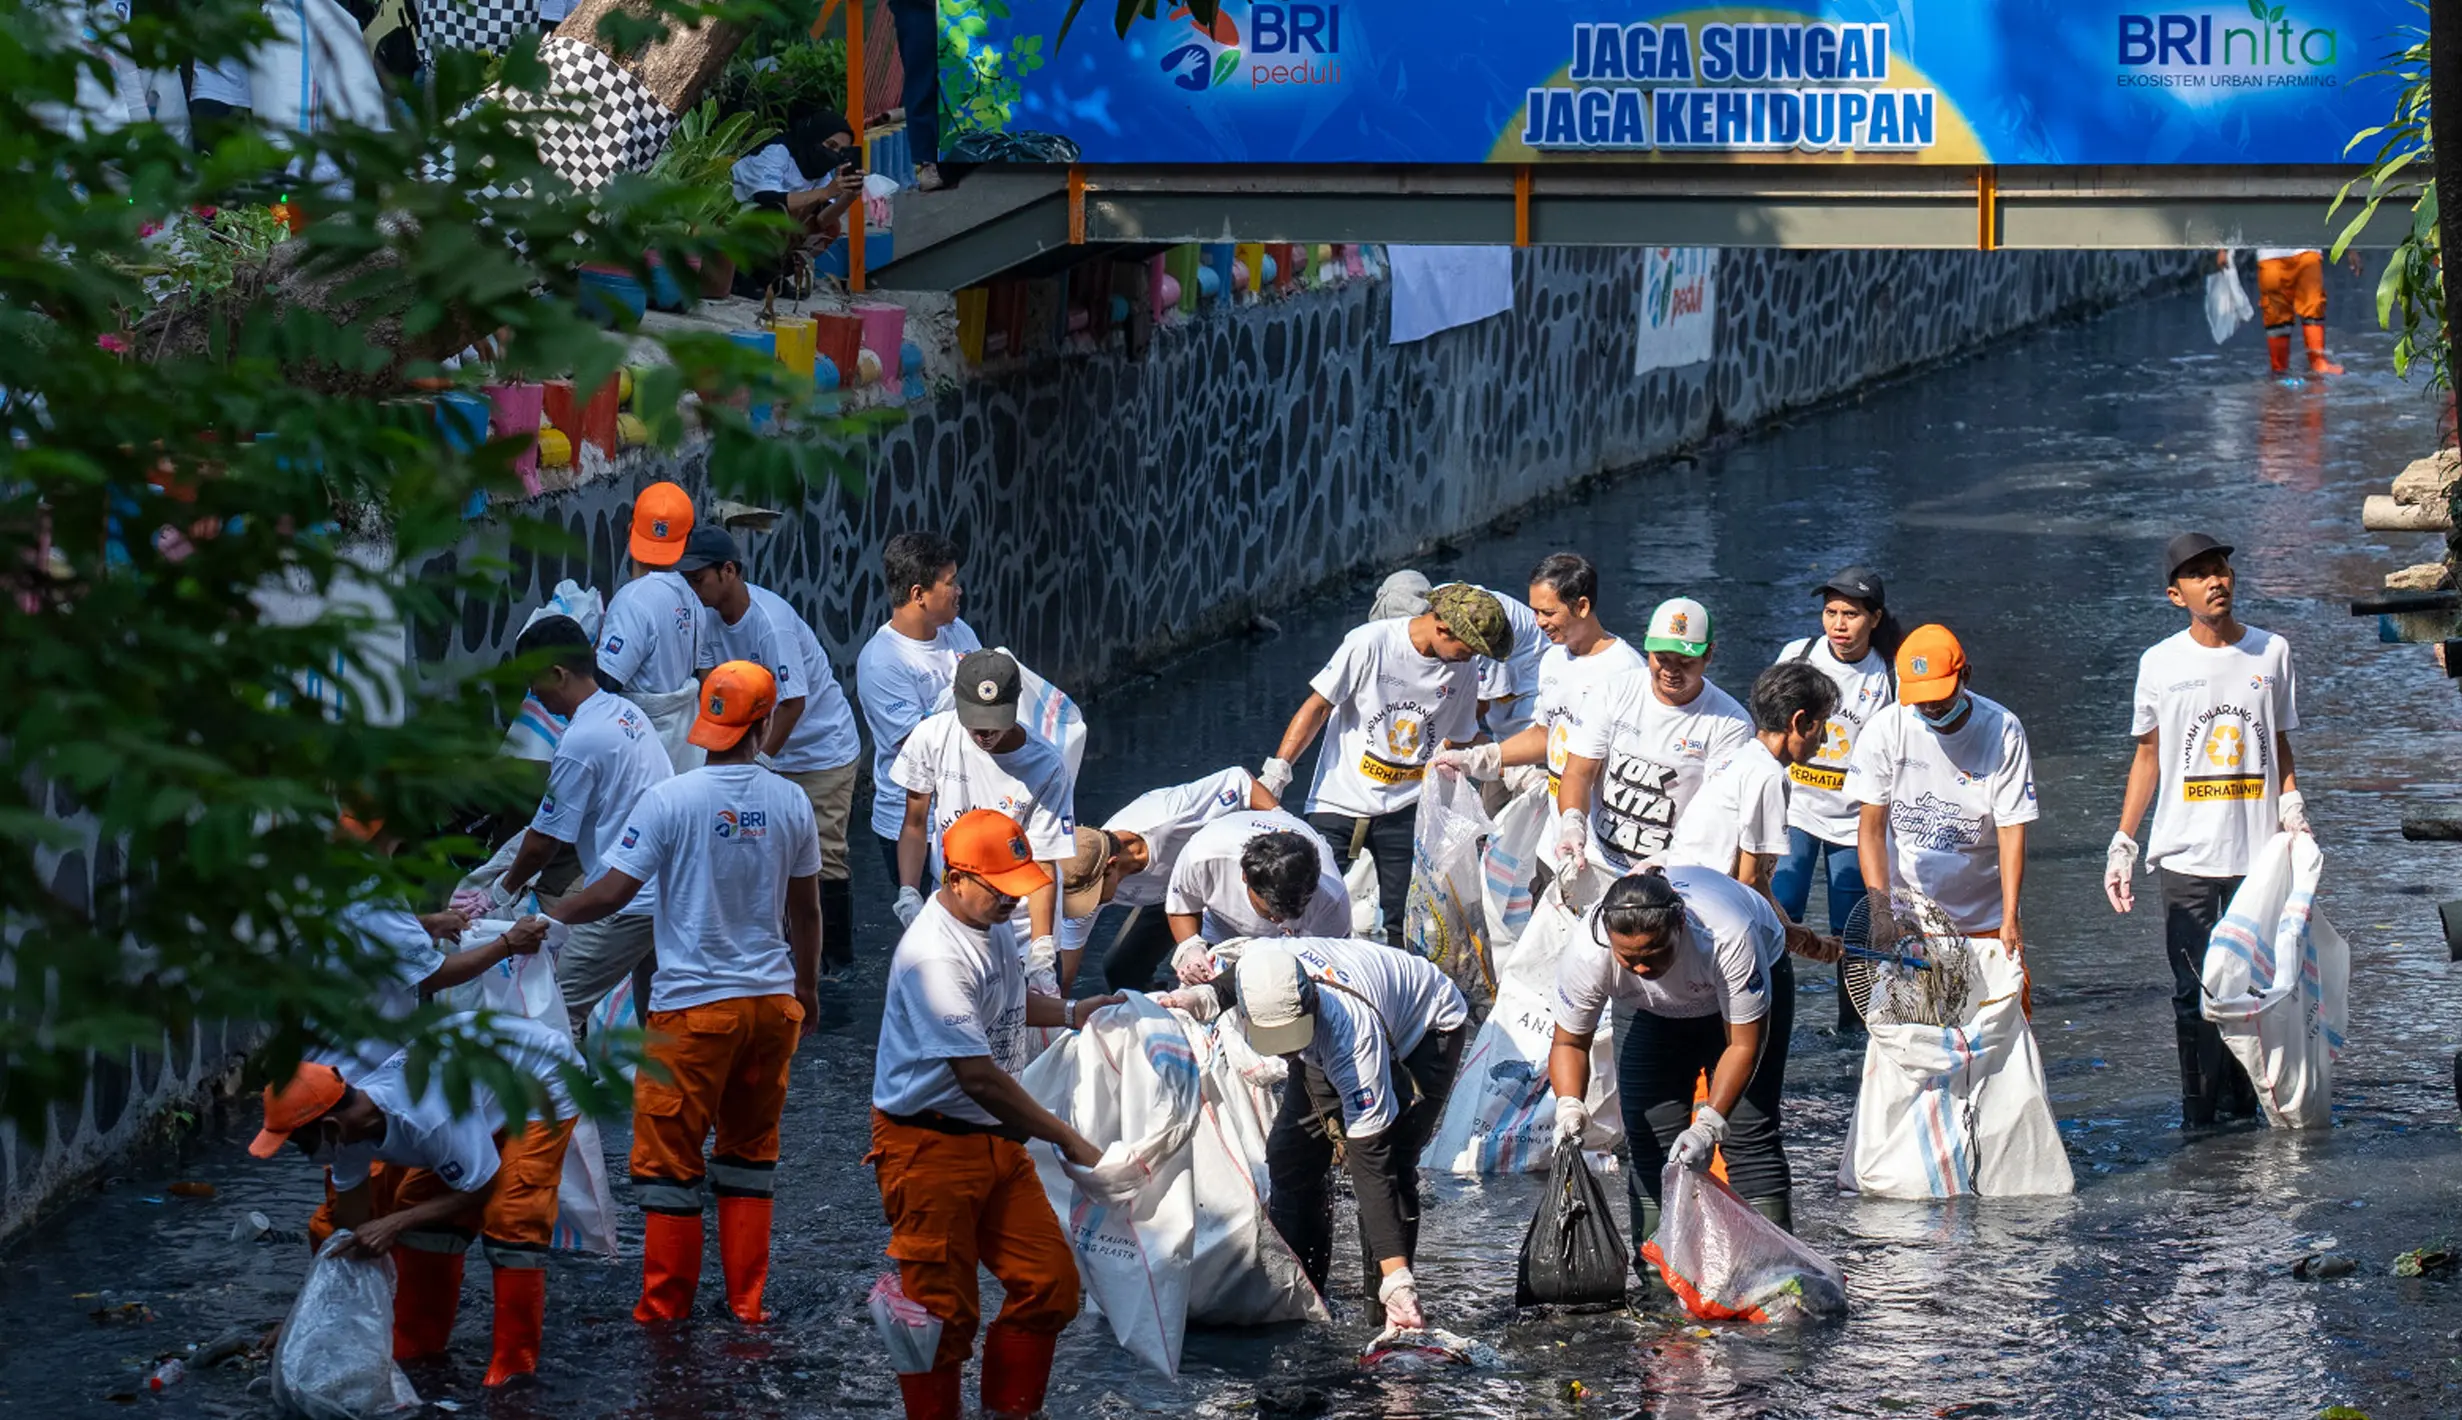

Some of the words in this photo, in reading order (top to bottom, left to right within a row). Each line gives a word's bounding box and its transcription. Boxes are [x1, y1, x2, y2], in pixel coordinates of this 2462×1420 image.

[1251, 4, 1339, 53] BRI
[1569, 23, 1697, 83] JAGA
[1700, 23, 1890, 83] SUNGAI
[1252, 59, 1341, 90] peduli
[2117, 75, 2206, 87] EKOSISTEM
[2210, 75, 2263, 87] URBAN
[2267, 75, 2338, 87] FARMING
[1521, 87, 1650, 148] JAGA
[1652, 87, 1937, 149] KEHIDUPAN
[1609, 748, 1678, 796] YOK
[741, 811, 767, 827] BRI
[1601, 778, 1676, 829] KITA
[1595, 807, 1674, 861] GAS
